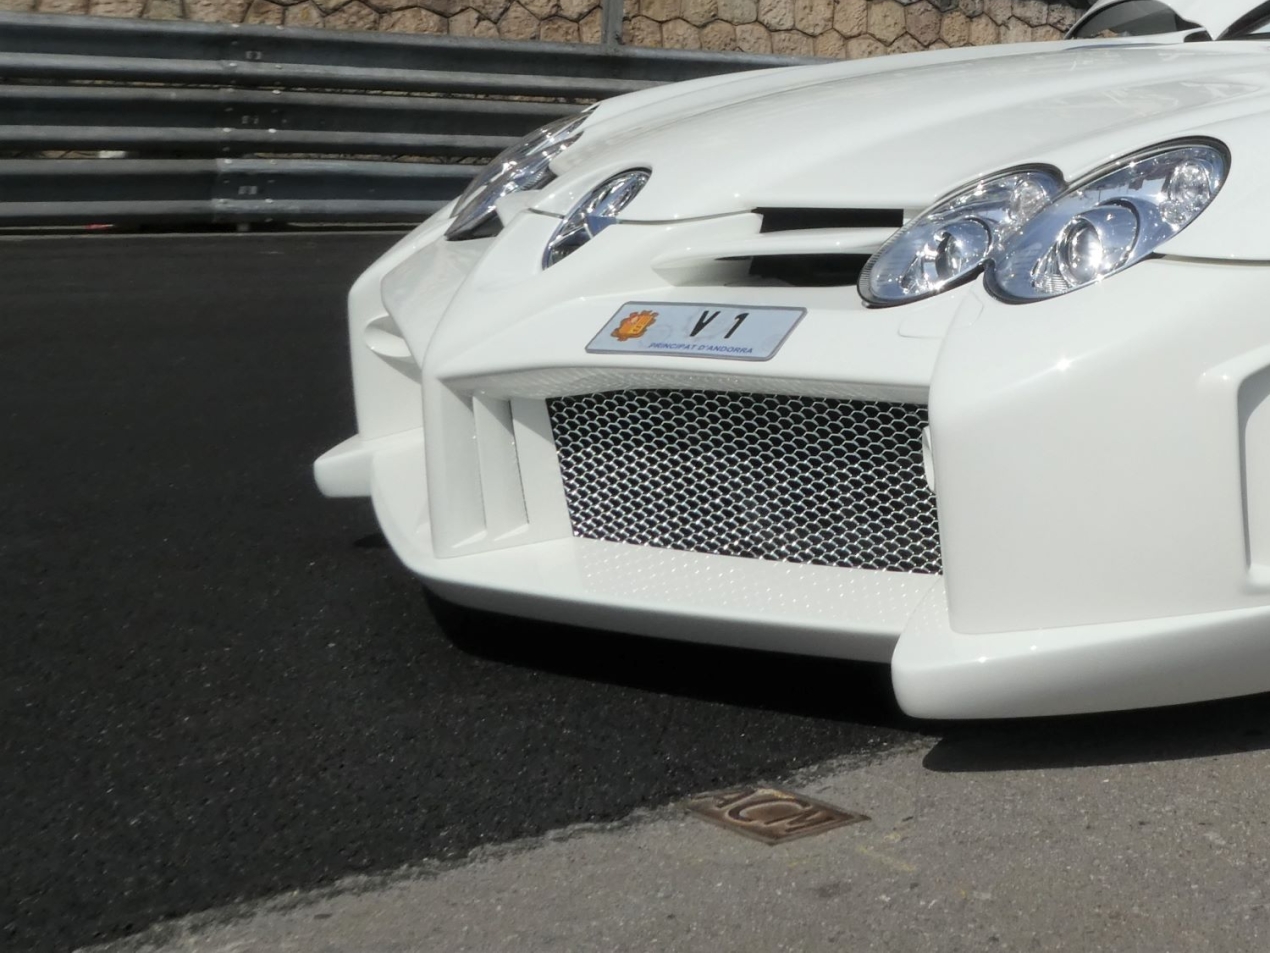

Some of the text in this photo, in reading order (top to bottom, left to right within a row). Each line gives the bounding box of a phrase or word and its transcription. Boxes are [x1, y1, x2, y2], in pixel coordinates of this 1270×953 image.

[689, 310, 750, 340] V 1
[648, 342, 754, 354] PRINCIPAT D'ANDORRA
